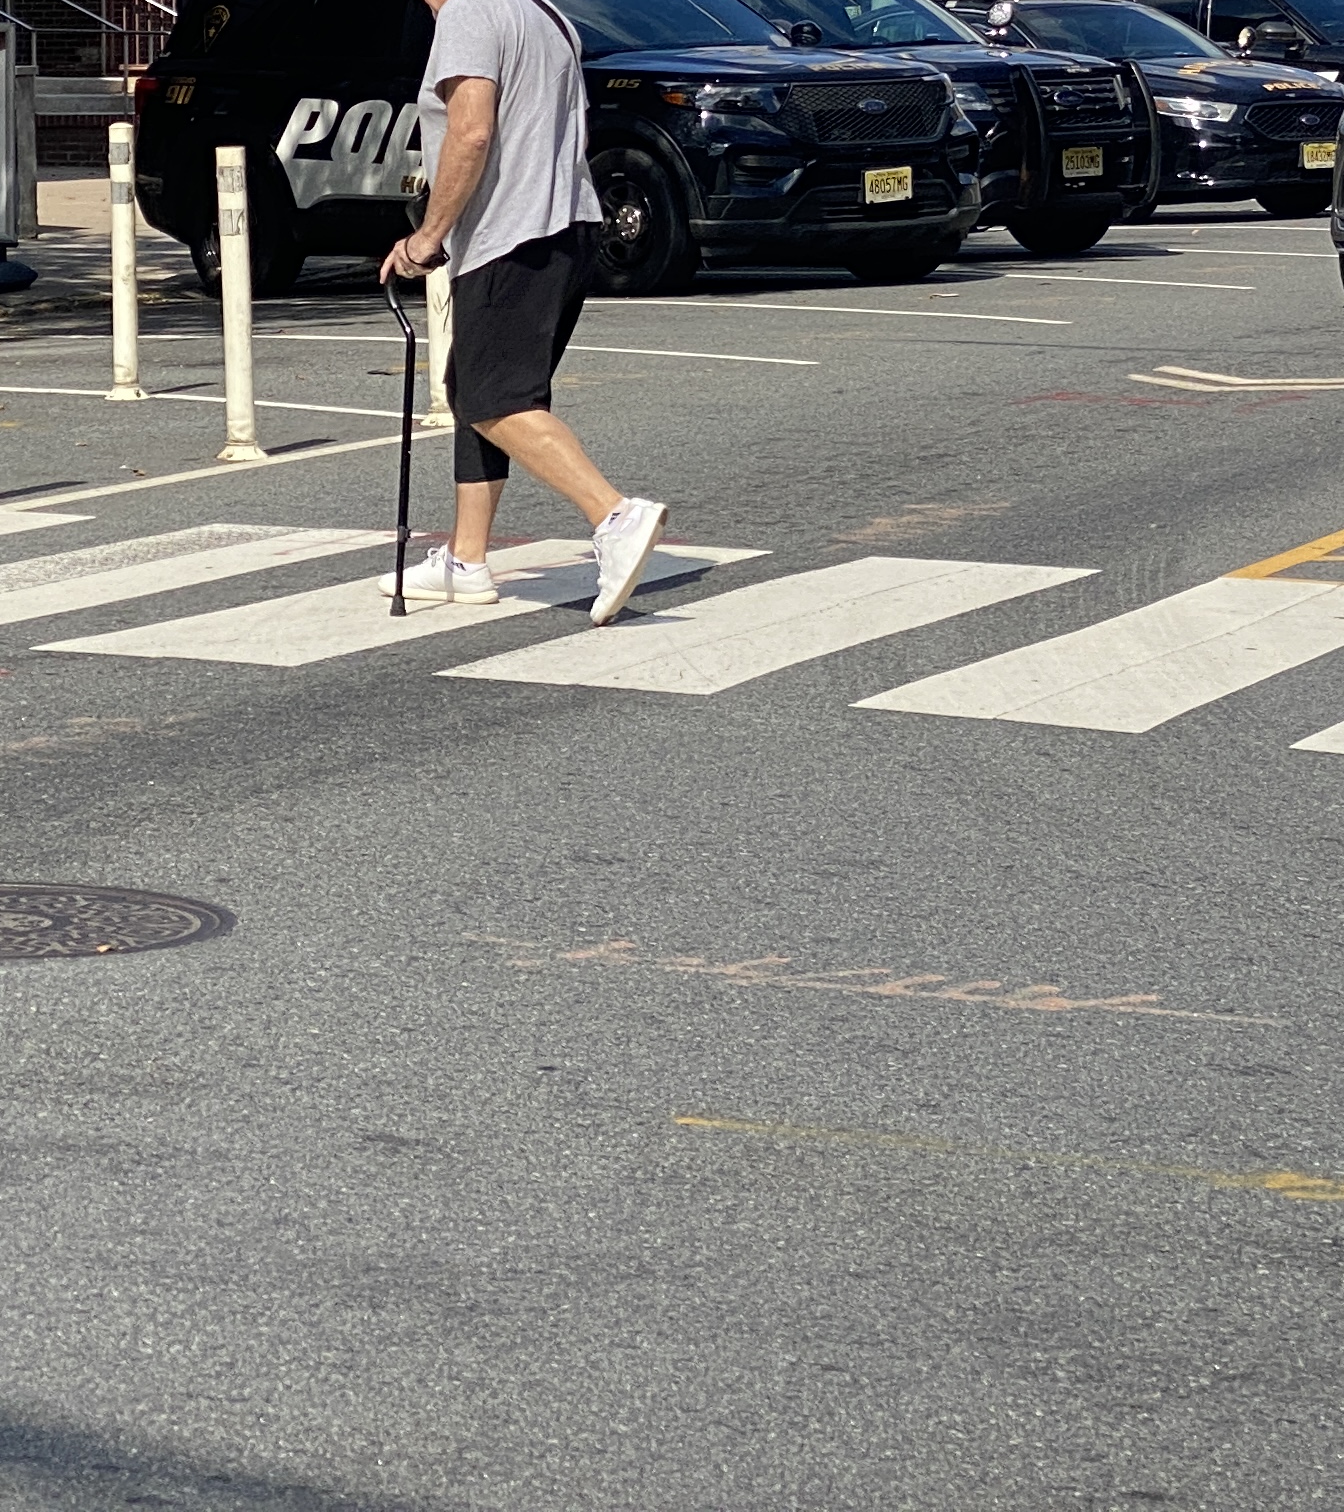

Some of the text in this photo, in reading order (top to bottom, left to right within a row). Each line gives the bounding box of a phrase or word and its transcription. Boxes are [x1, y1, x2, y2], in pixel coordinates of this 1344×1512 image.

[606, 78, 642, 88] 105
[165, 85, 194, 105] 911
[869, 175, 909, 194] 48057MG
